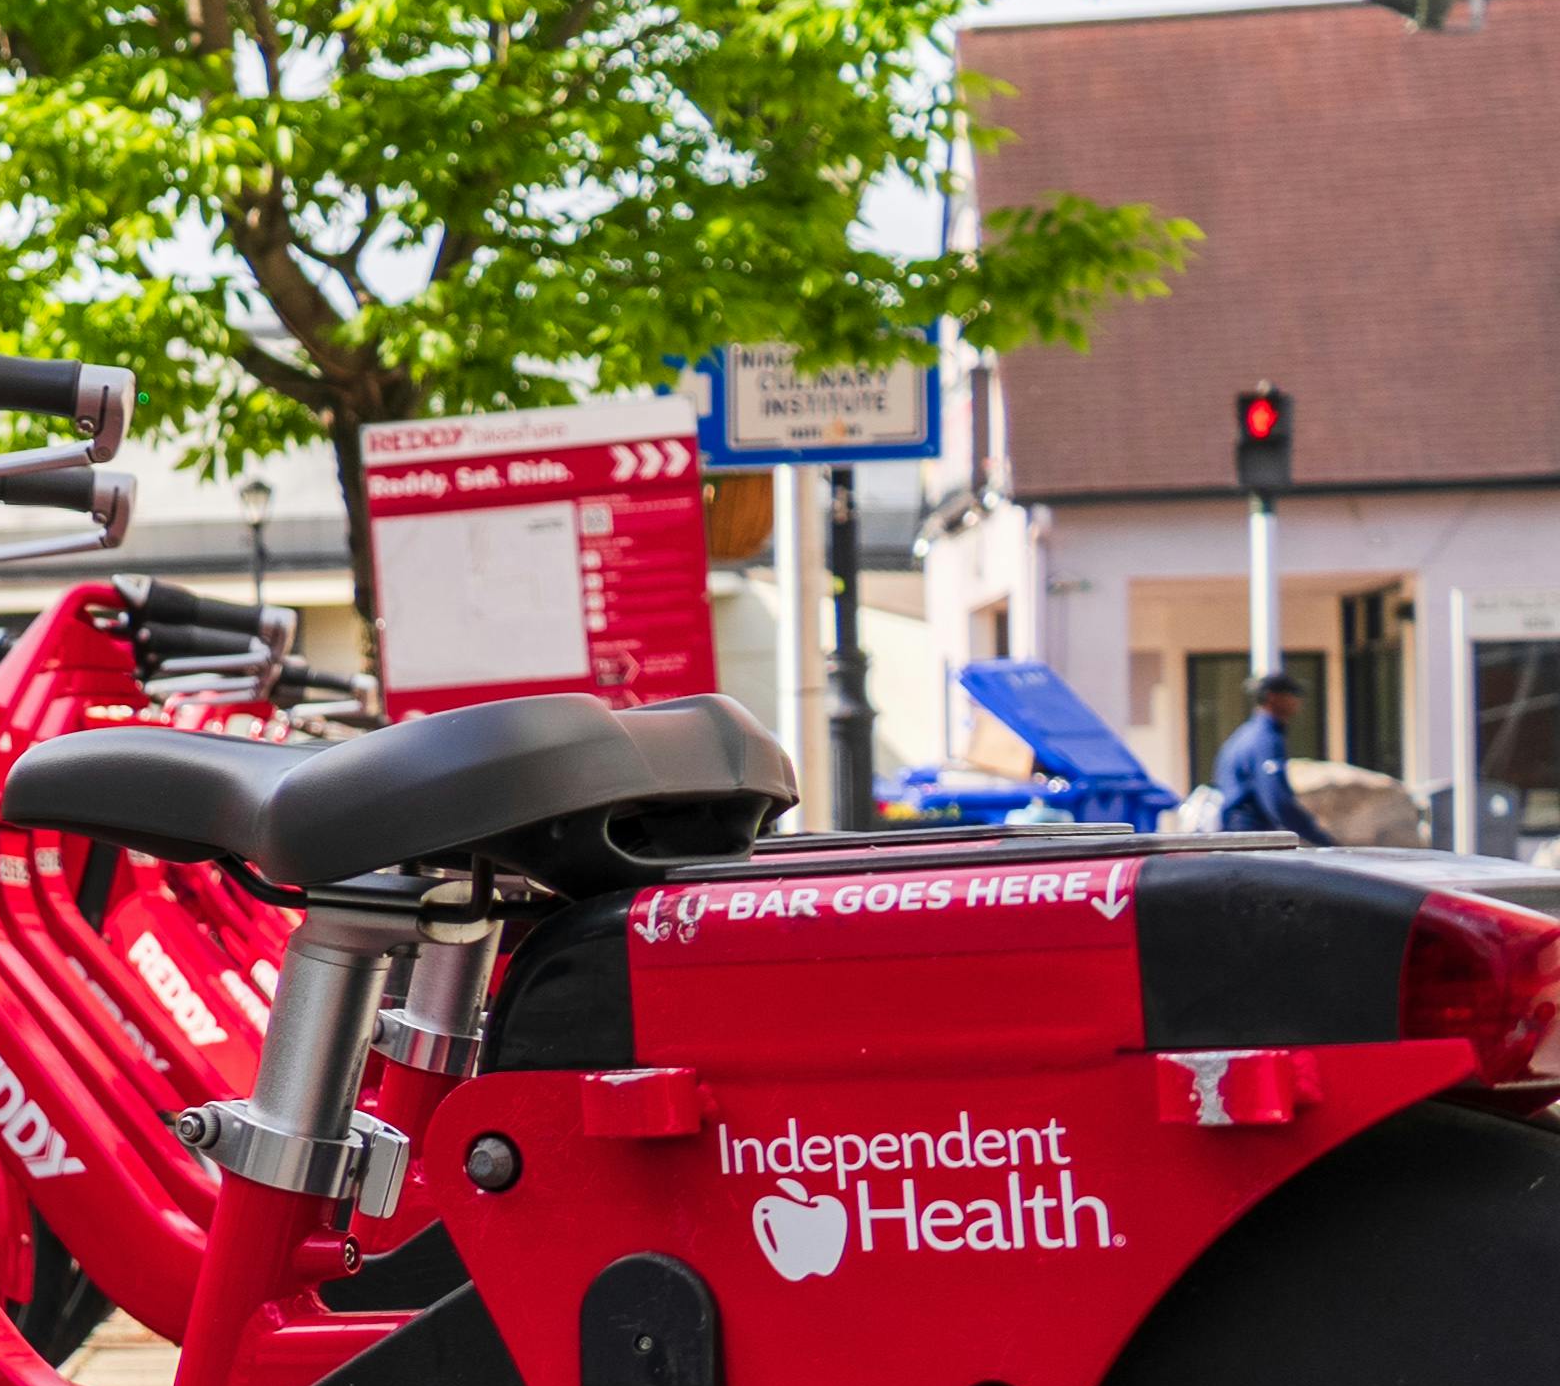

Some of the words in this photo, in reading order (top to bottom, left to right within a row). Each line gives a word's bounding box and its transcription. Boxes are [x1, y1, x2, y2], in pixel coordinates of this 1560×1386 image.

[763, 393, 888, 417] INSTITUTE
[368, 426, 463, 454] REDDY
[678, 885, 821, 924] U-BAR
[832, 878, 954, 915] GOES
[965, 870, 1093, 908] HERE
[128, 931, 228, 1046] REDDY
[718, 1109, 1072, 1191] Independent
